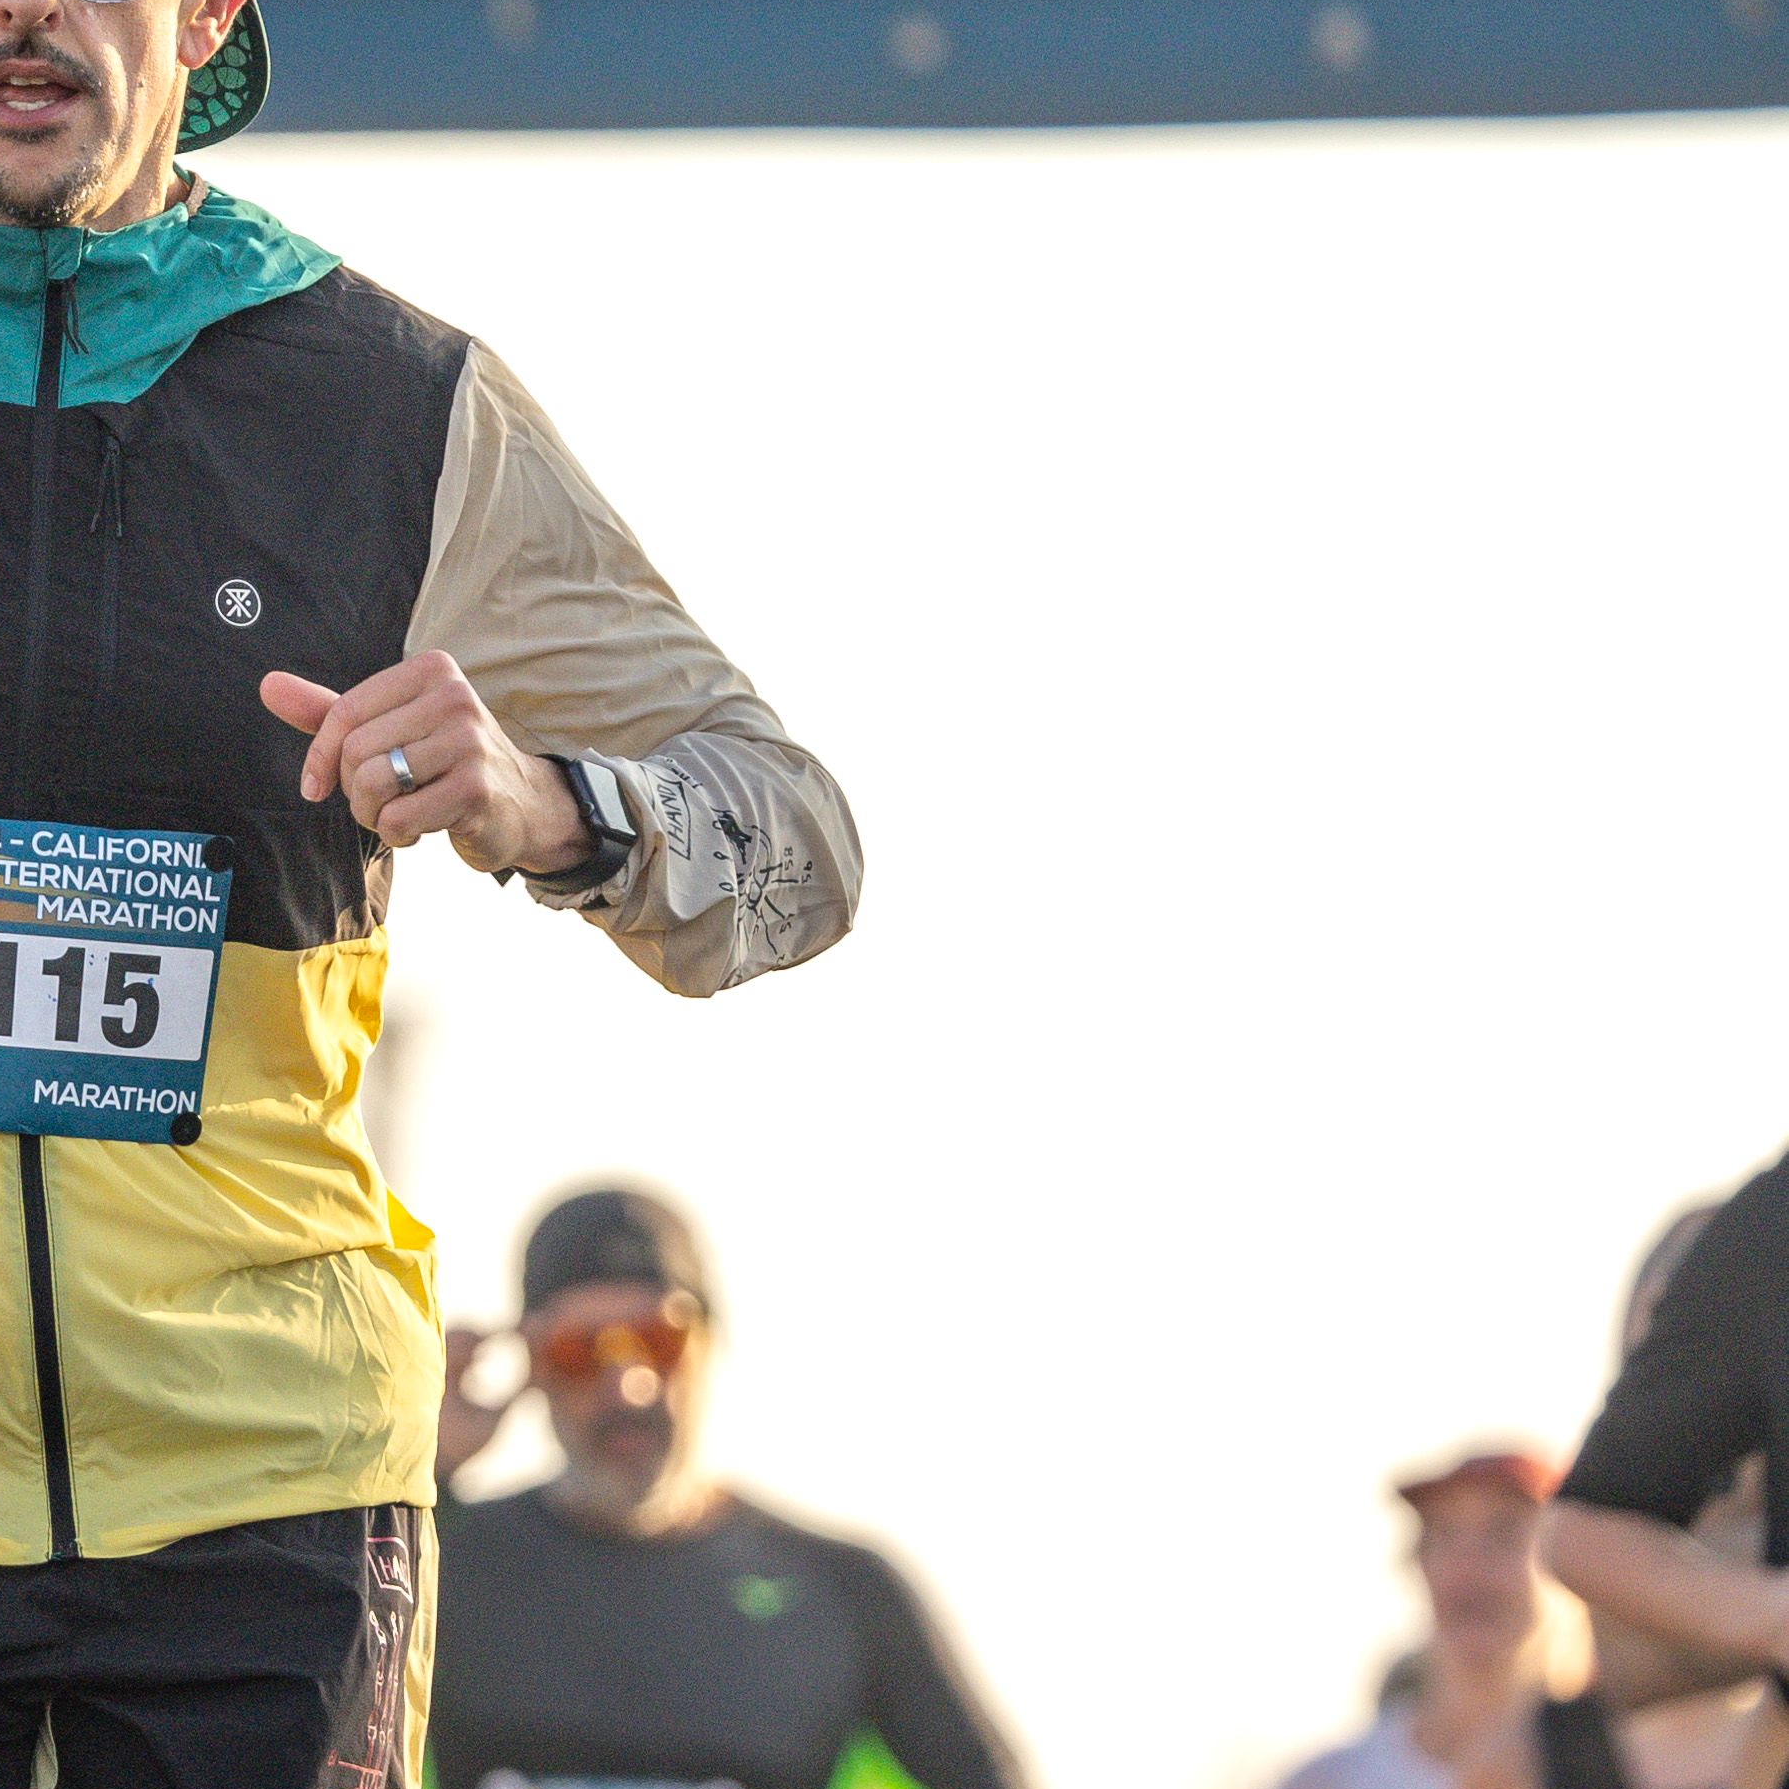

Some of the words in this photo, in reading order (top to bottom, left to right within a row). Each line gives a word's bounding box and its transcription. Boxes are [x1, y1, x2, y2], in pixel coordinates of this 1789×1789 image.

[31, 831, 207, 869] CALIFORNI
[35, 894, 219, 934] MARATHON
[34, 1079, 197, 1114] MARATHON
